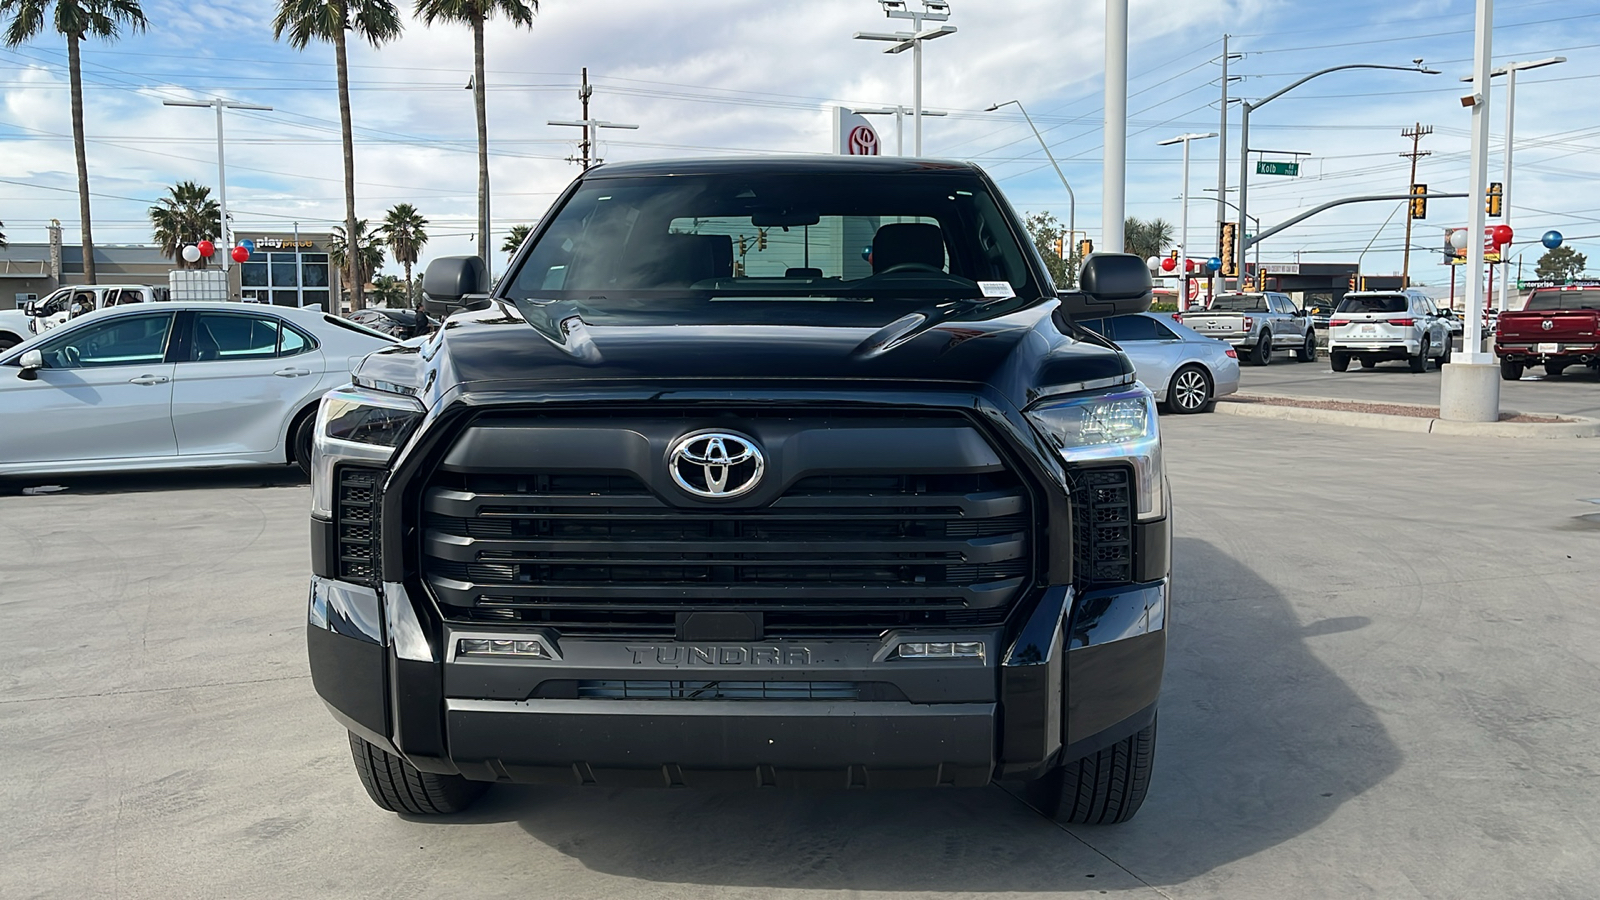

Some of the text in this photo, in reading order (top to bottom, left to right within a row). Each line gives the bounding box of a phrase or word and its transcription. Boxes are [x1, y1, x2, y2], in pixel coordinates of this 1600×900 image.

[1261, 163, 1276, 173] Kolb
[1519, 280, 1554, 288] enterprise
[625, 646, 812, 665] TUNDRA
